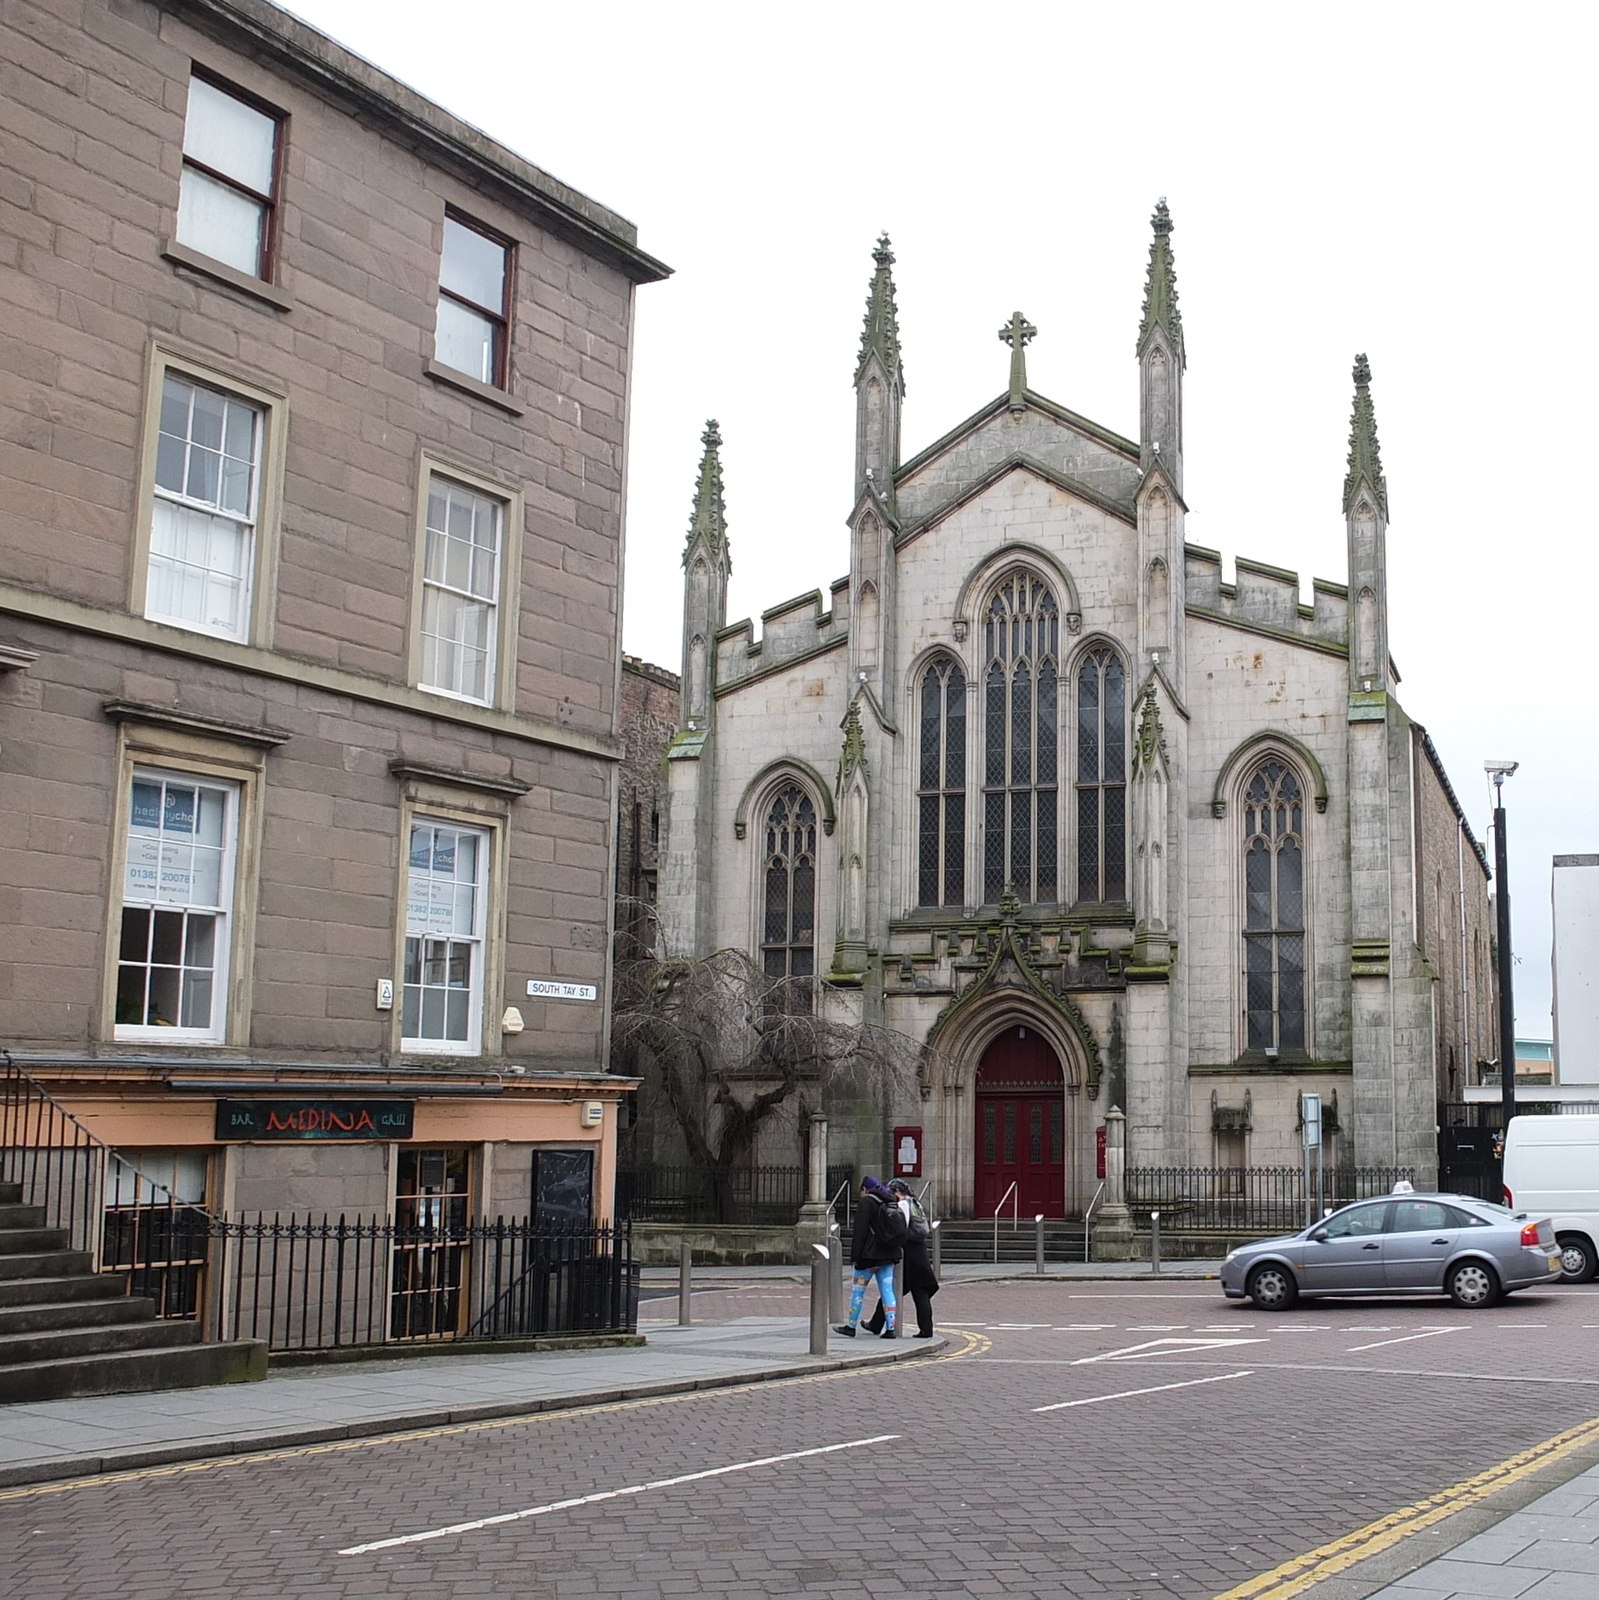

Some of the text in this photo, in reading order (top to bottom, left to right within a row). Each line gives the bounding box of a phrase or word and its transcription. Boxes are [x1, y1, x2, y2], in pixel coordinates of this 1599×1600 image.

[134, 806, 194, 823] healycha
[532, 982, 560, 995] SOUTH
[563, 985, 577, 996] TAY
[230, 1113, 255, 1126] BAR
[265, 1107, 376, 1131] MEDINA
